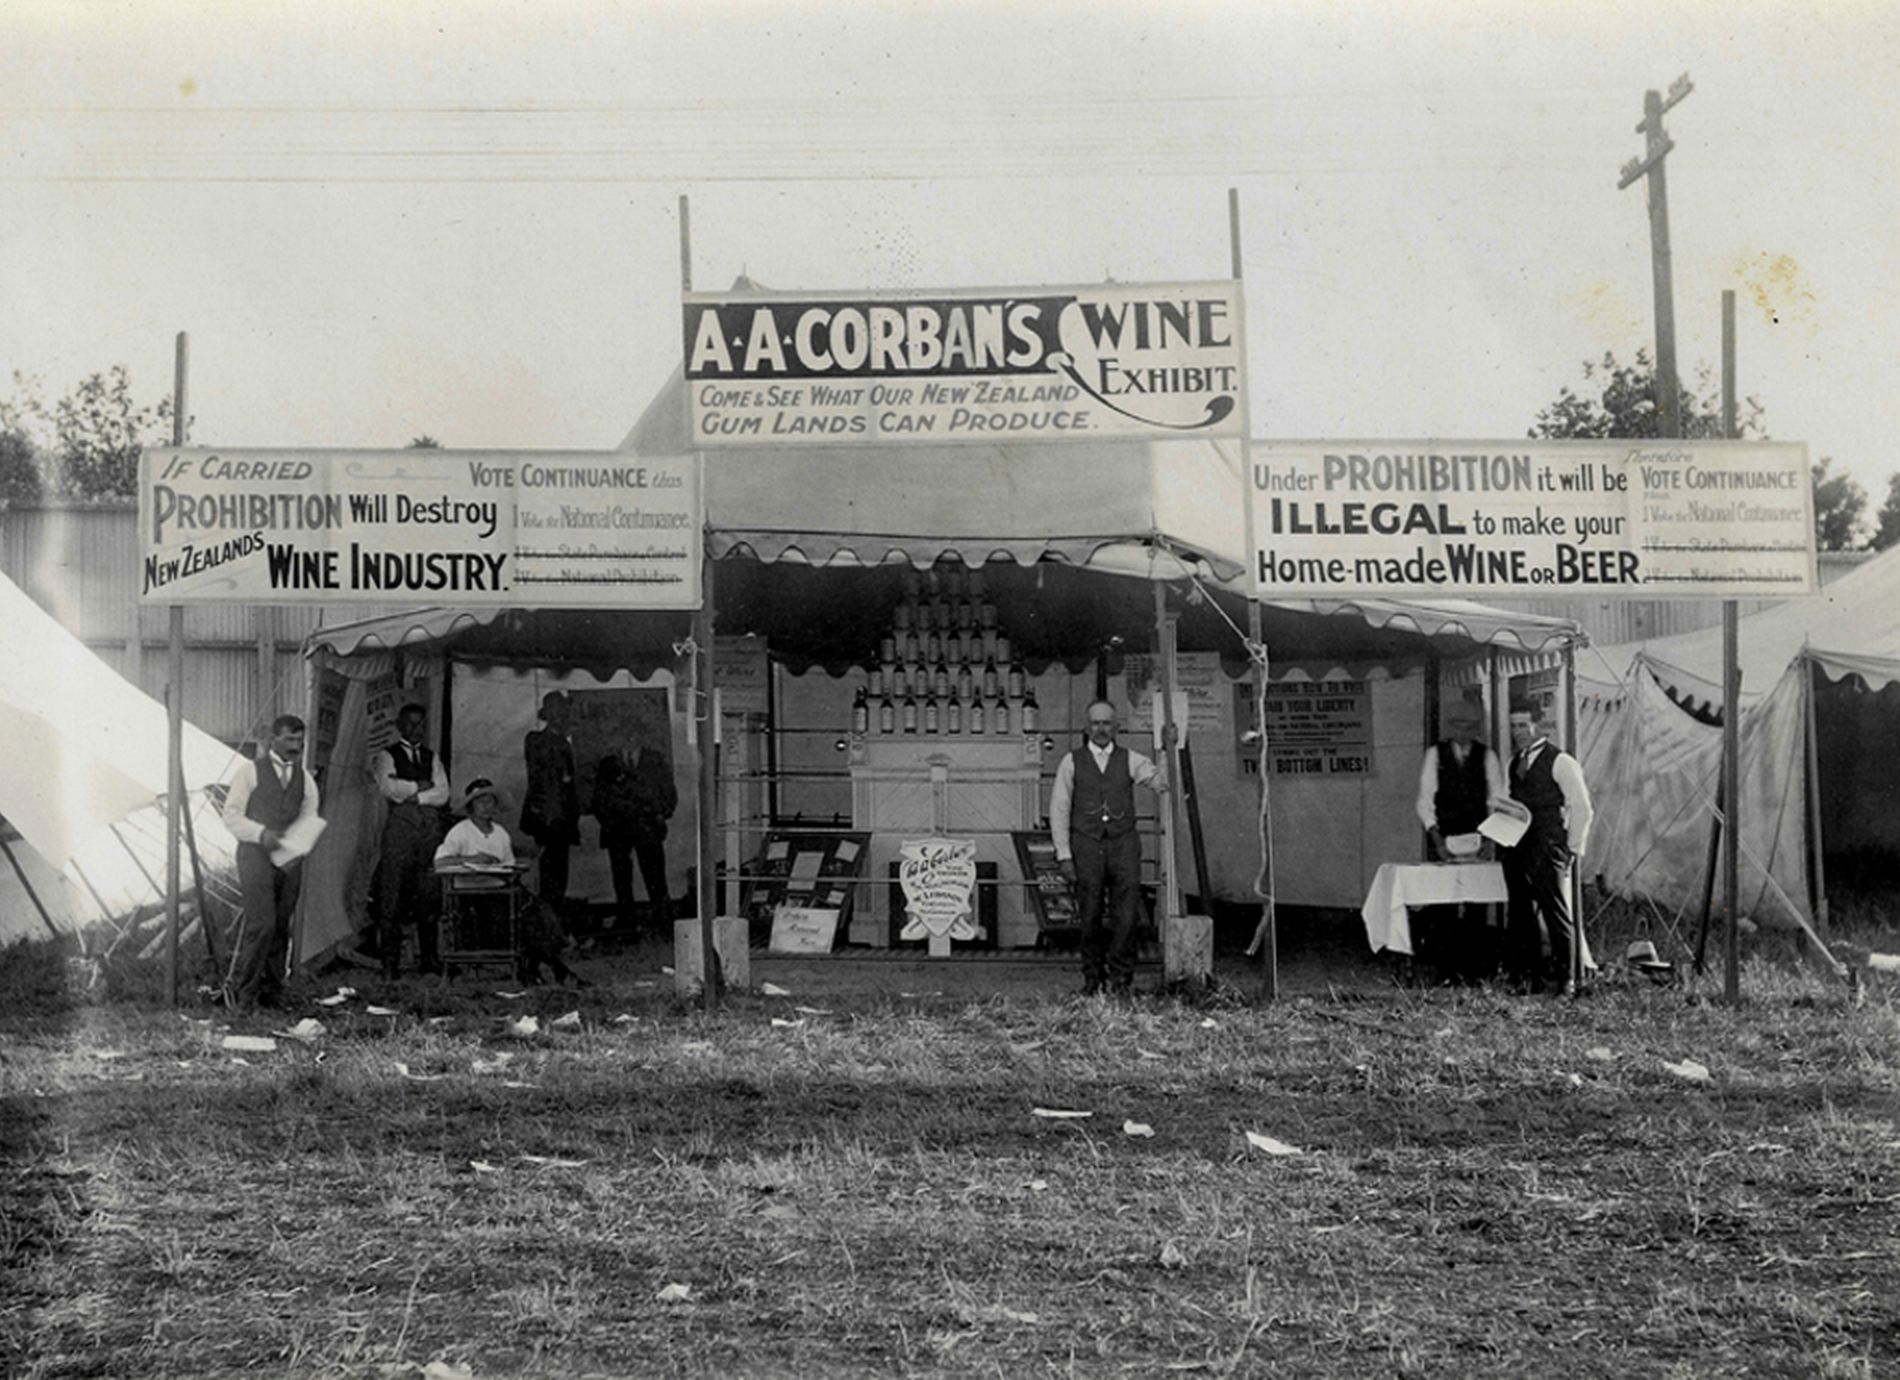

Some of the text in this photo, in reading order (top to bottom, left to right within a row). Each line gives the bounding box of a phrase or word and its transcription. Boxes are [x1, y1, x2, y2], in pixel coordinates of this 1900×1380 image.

[795, 300, 1044, 372] CORBAN'S
[1079, 300, 1232, 350] WINE
[700, 385, 752, 408] COME
[767, 385, 804, 407] SEE
[810, 385, 864, 407] WHAT
[870, 384, 914, 406] OUR
[920, 382, 970, 405] NEW
[973, 381, 1080, 404] ZEALAND
[1097, 358, 1238, 395] EXHIBIT.
[701, 409, 1099, 435] GUM LANDS CAN PRODUCE.
[161, 455, 313, 480] IF CARRIED
[469, 462, 514, 488] VOTE
[521, 463, 648, 488] CONTINUANCE
[1254, 455, 1628, 492] Under PROHIBITION it will be
[1641, 465, 1798, 490] VOTE CONTINUANCE
[153, 484, 497, 544] PROHIBITION Will Destroy
[1271, 498, 1466, 535] ILLEGAL
[1473, 509, 1496, 535] to
[1503, 506, 1566, 535] make
[1575, 516, 1626, 545] your
[143, 531, 265, 596] NEW ZEALANDS
[267, 543, 509, 591] WINE INDUSTRY.
[1258, 547, 1447, 584] Home-made
[1445, 544, 1529, 584] WINE
[1530, 568, 1556, 584] OR
[1277, 757, 1322, 773] BOTTOM
